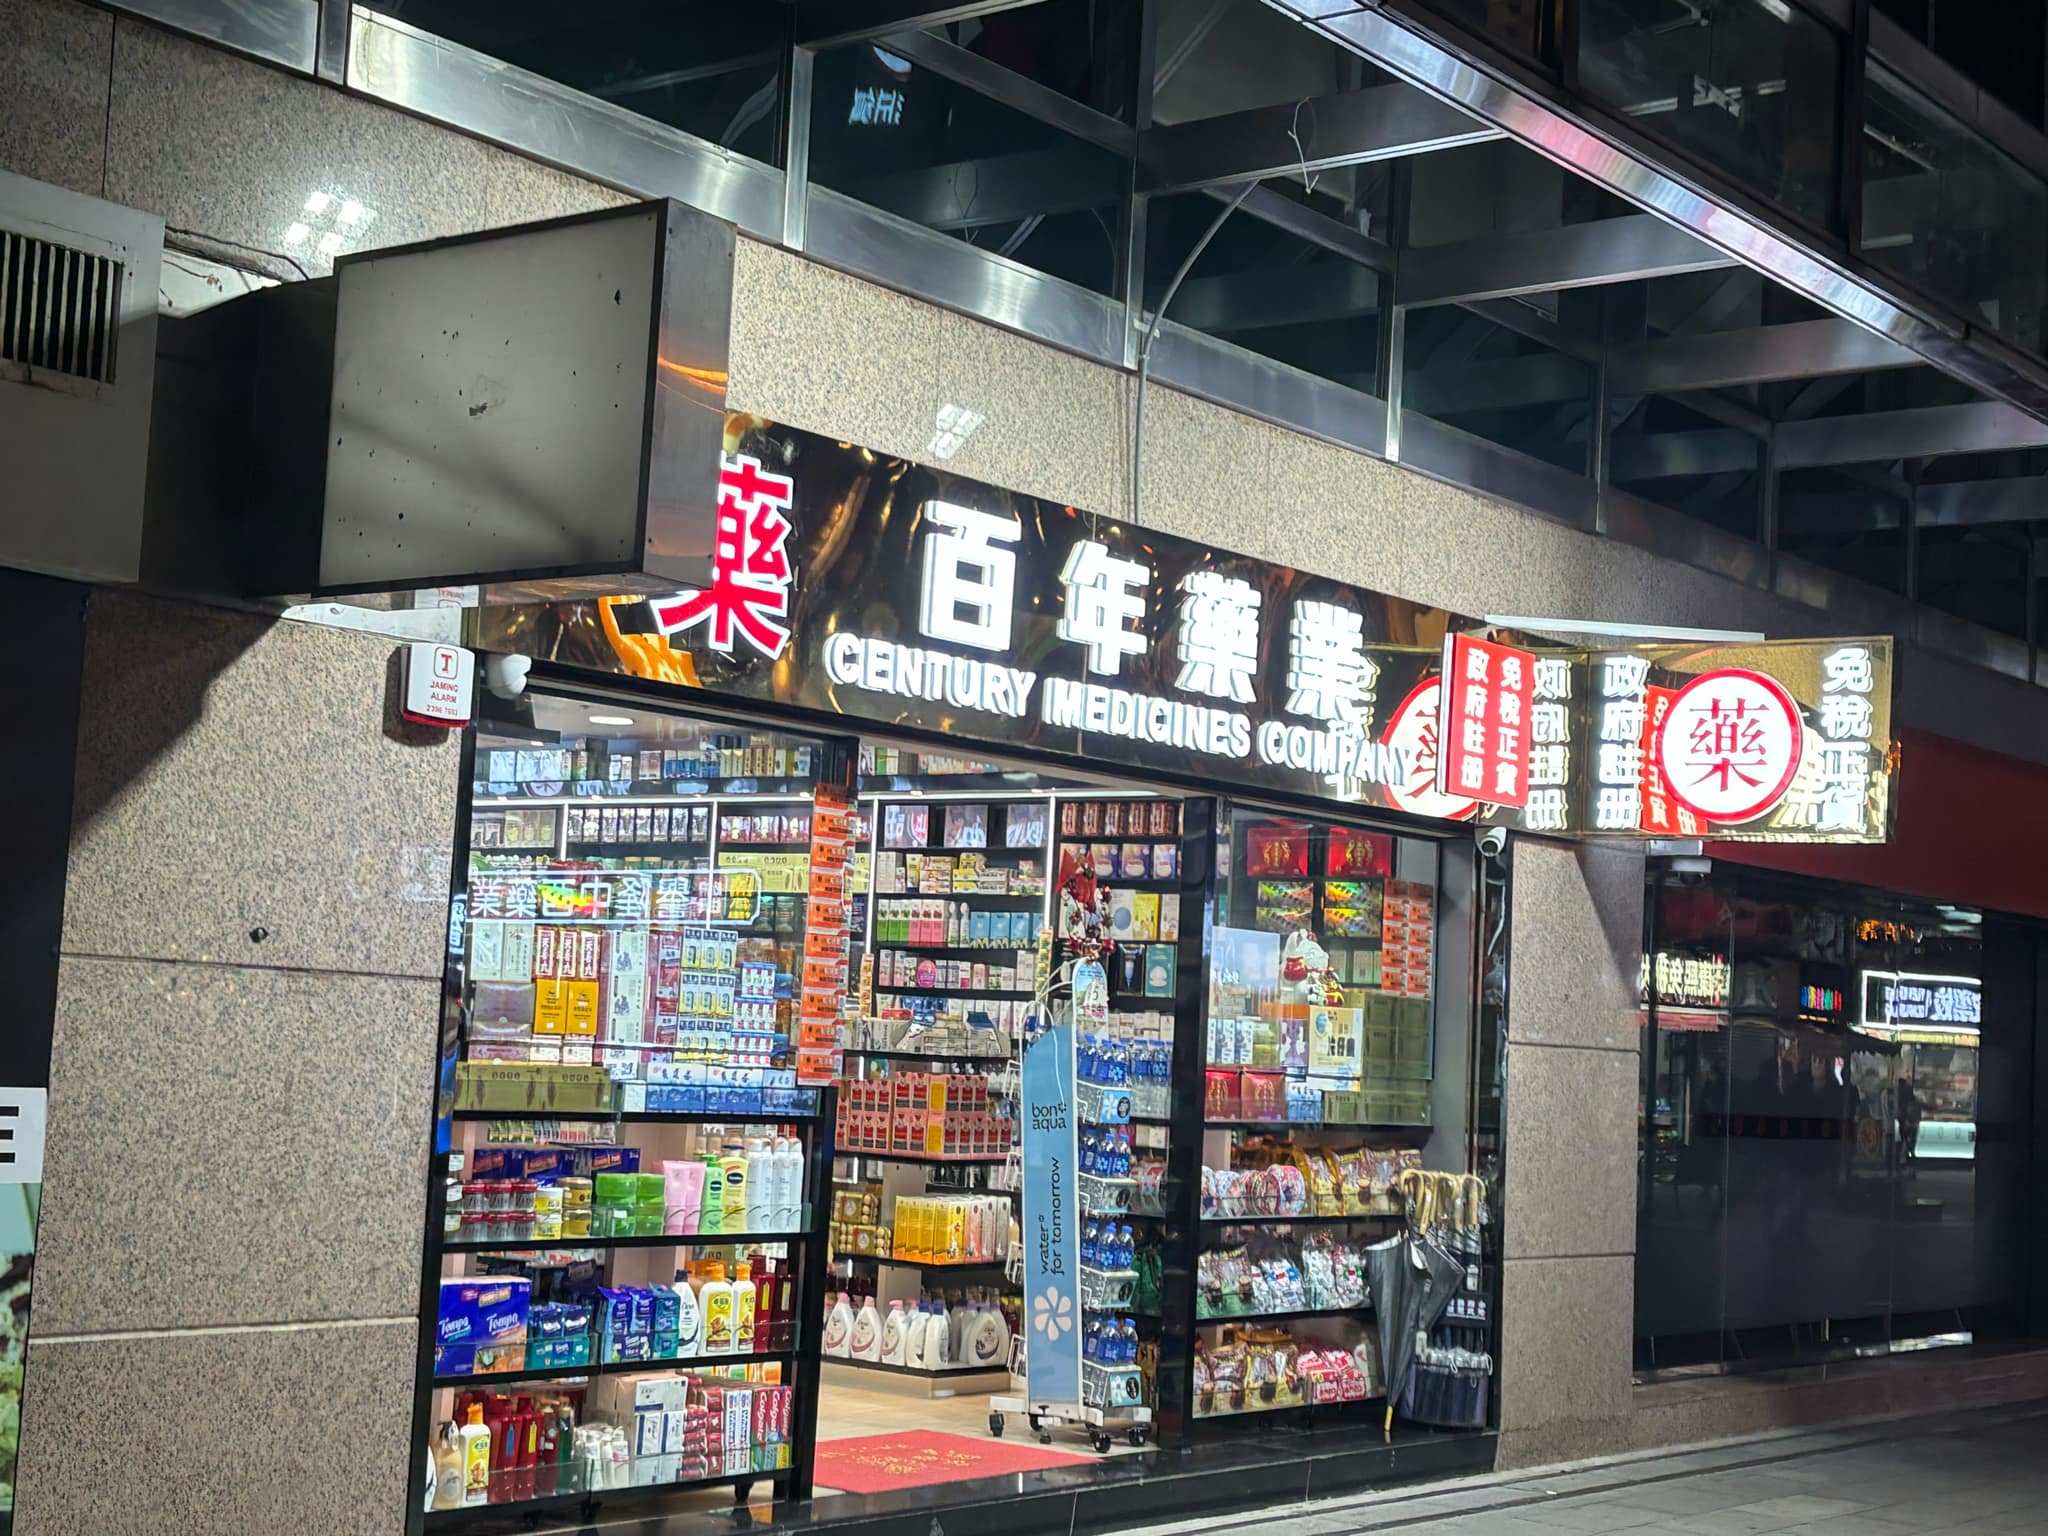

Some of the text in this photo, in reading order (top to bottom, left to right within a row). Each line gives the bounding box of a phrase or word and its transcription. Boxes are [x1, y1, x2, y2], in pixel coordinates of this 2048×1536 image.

[918, 500, 1364, 720] 百年藥業
[431, 692, 457, 704] ALARM
[823, 632, 1037, 717] CENTURY
[1042, 676, 1251, 759] MEDICINES
[1256, 719, 1414, 788] COMPANY
[1460, 647, 1490, 790] 政府註冊
[1495, 655, 1524, 797] 免稅正貨
[1598, 655, 1649, 830] 政府註冊
[1685, 697, 1770, 792] 藥
[1816, 647, 1873, 831] 免稅正貨
[1032, 1102, 1058, 1117] bon
[1032, 1117, 1067, 1133] aqua
[1050, 1156, 1064, 1276] for tomorrow
[438, 1315, 470, 1335] Tempo
[486, 1312, 519, 1331] Tempo
[756, 1391, 767, 1443] Colgate
[770, 1390, 780, 1432] Colgat
[782, 1390, 792, 1438] Colgate
